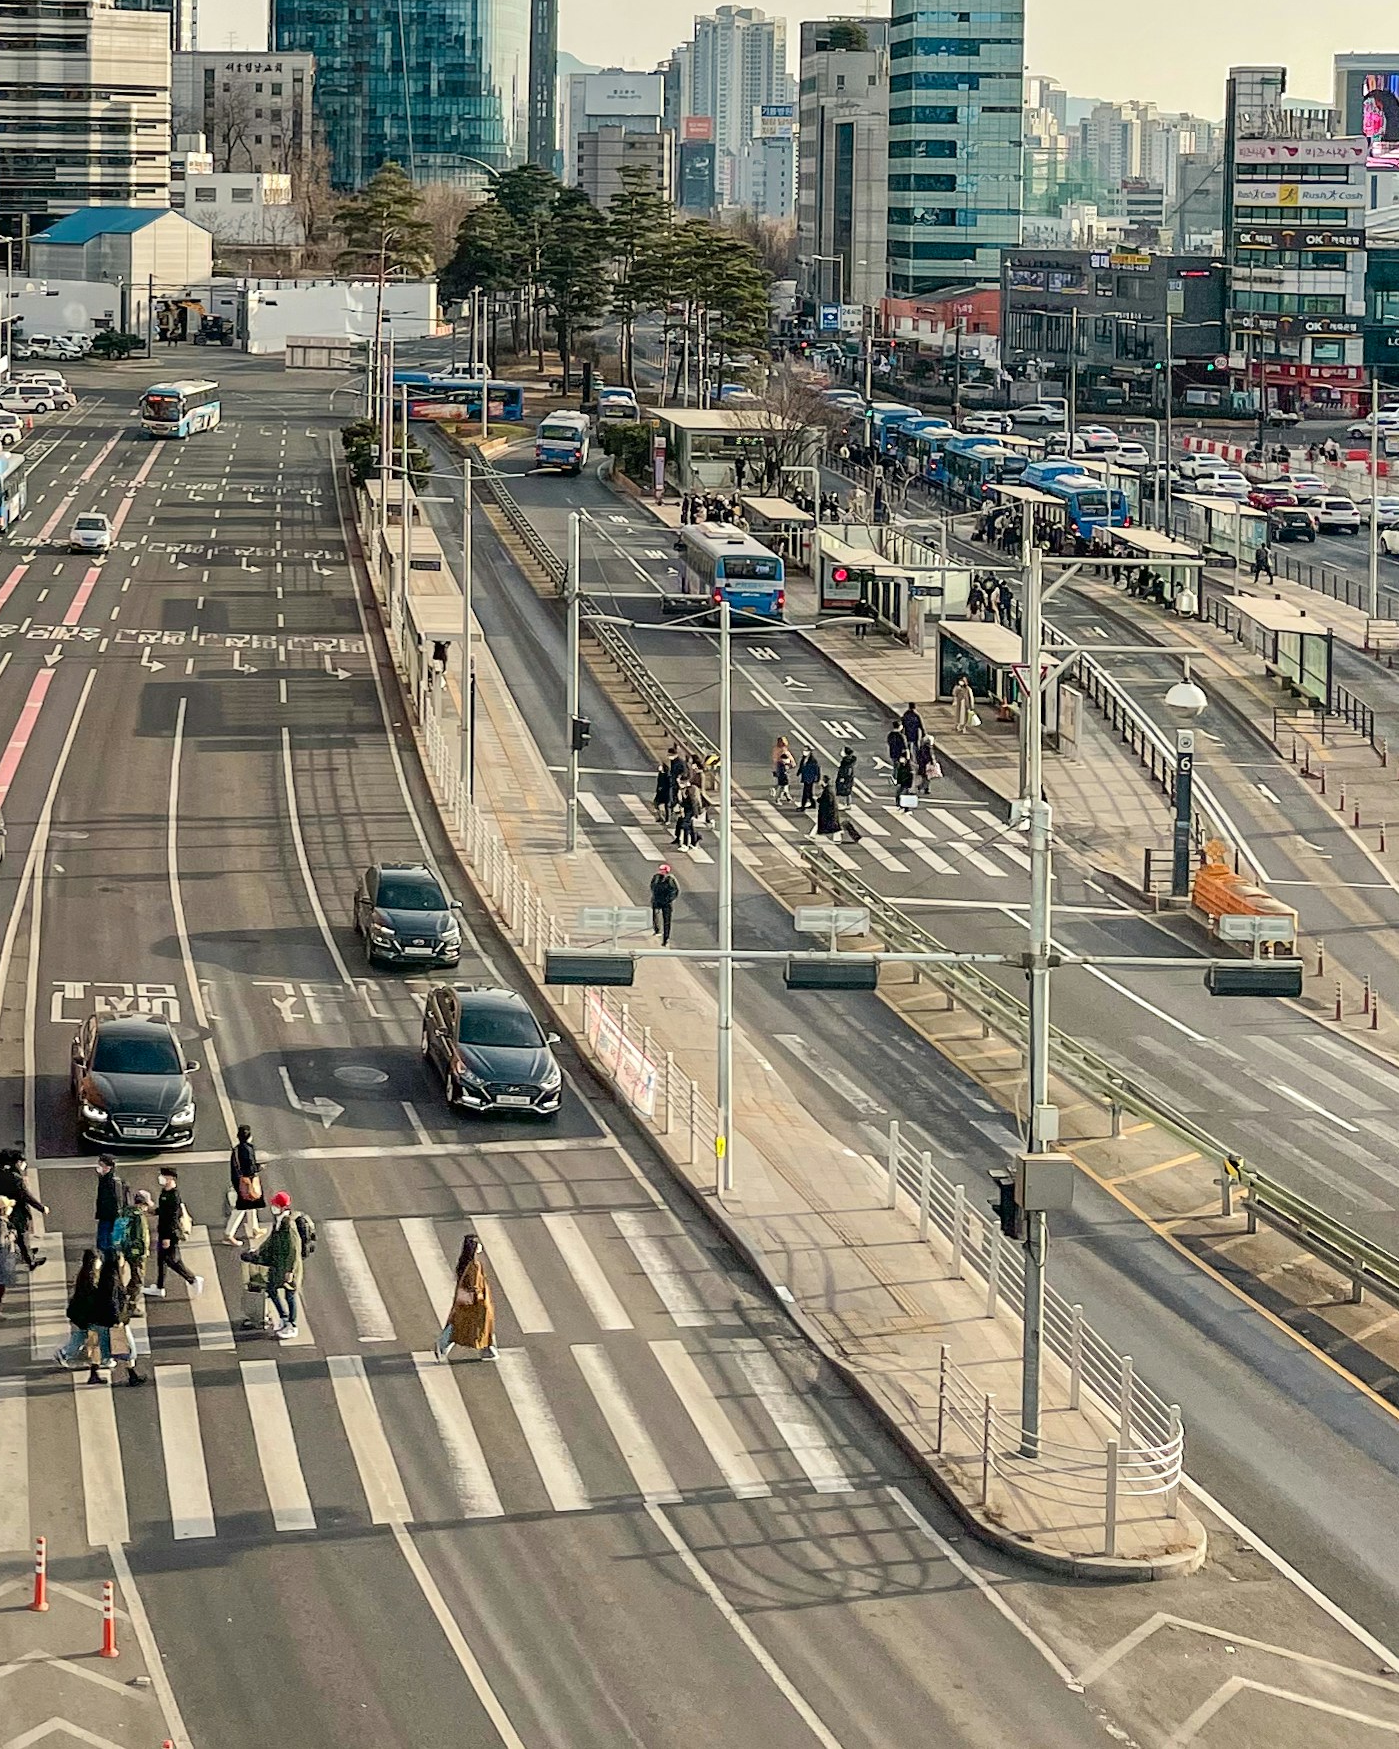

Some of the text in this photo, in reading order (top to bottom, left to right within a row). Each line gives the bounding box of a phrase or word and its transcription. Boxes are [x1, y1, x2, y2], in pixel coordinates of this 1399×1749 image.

[1302, 189, 1363, 200] Rush Cash
[1306, 235, 1323, 245] OK
[1305, 321, 1322, 331] OK
[25, 624, 102, 641] 숭례문
[113, 628, 189, 647] 염천교
[1180, 756, 1191, 771] 6
[49, 981, 182, 1025] 염천교
